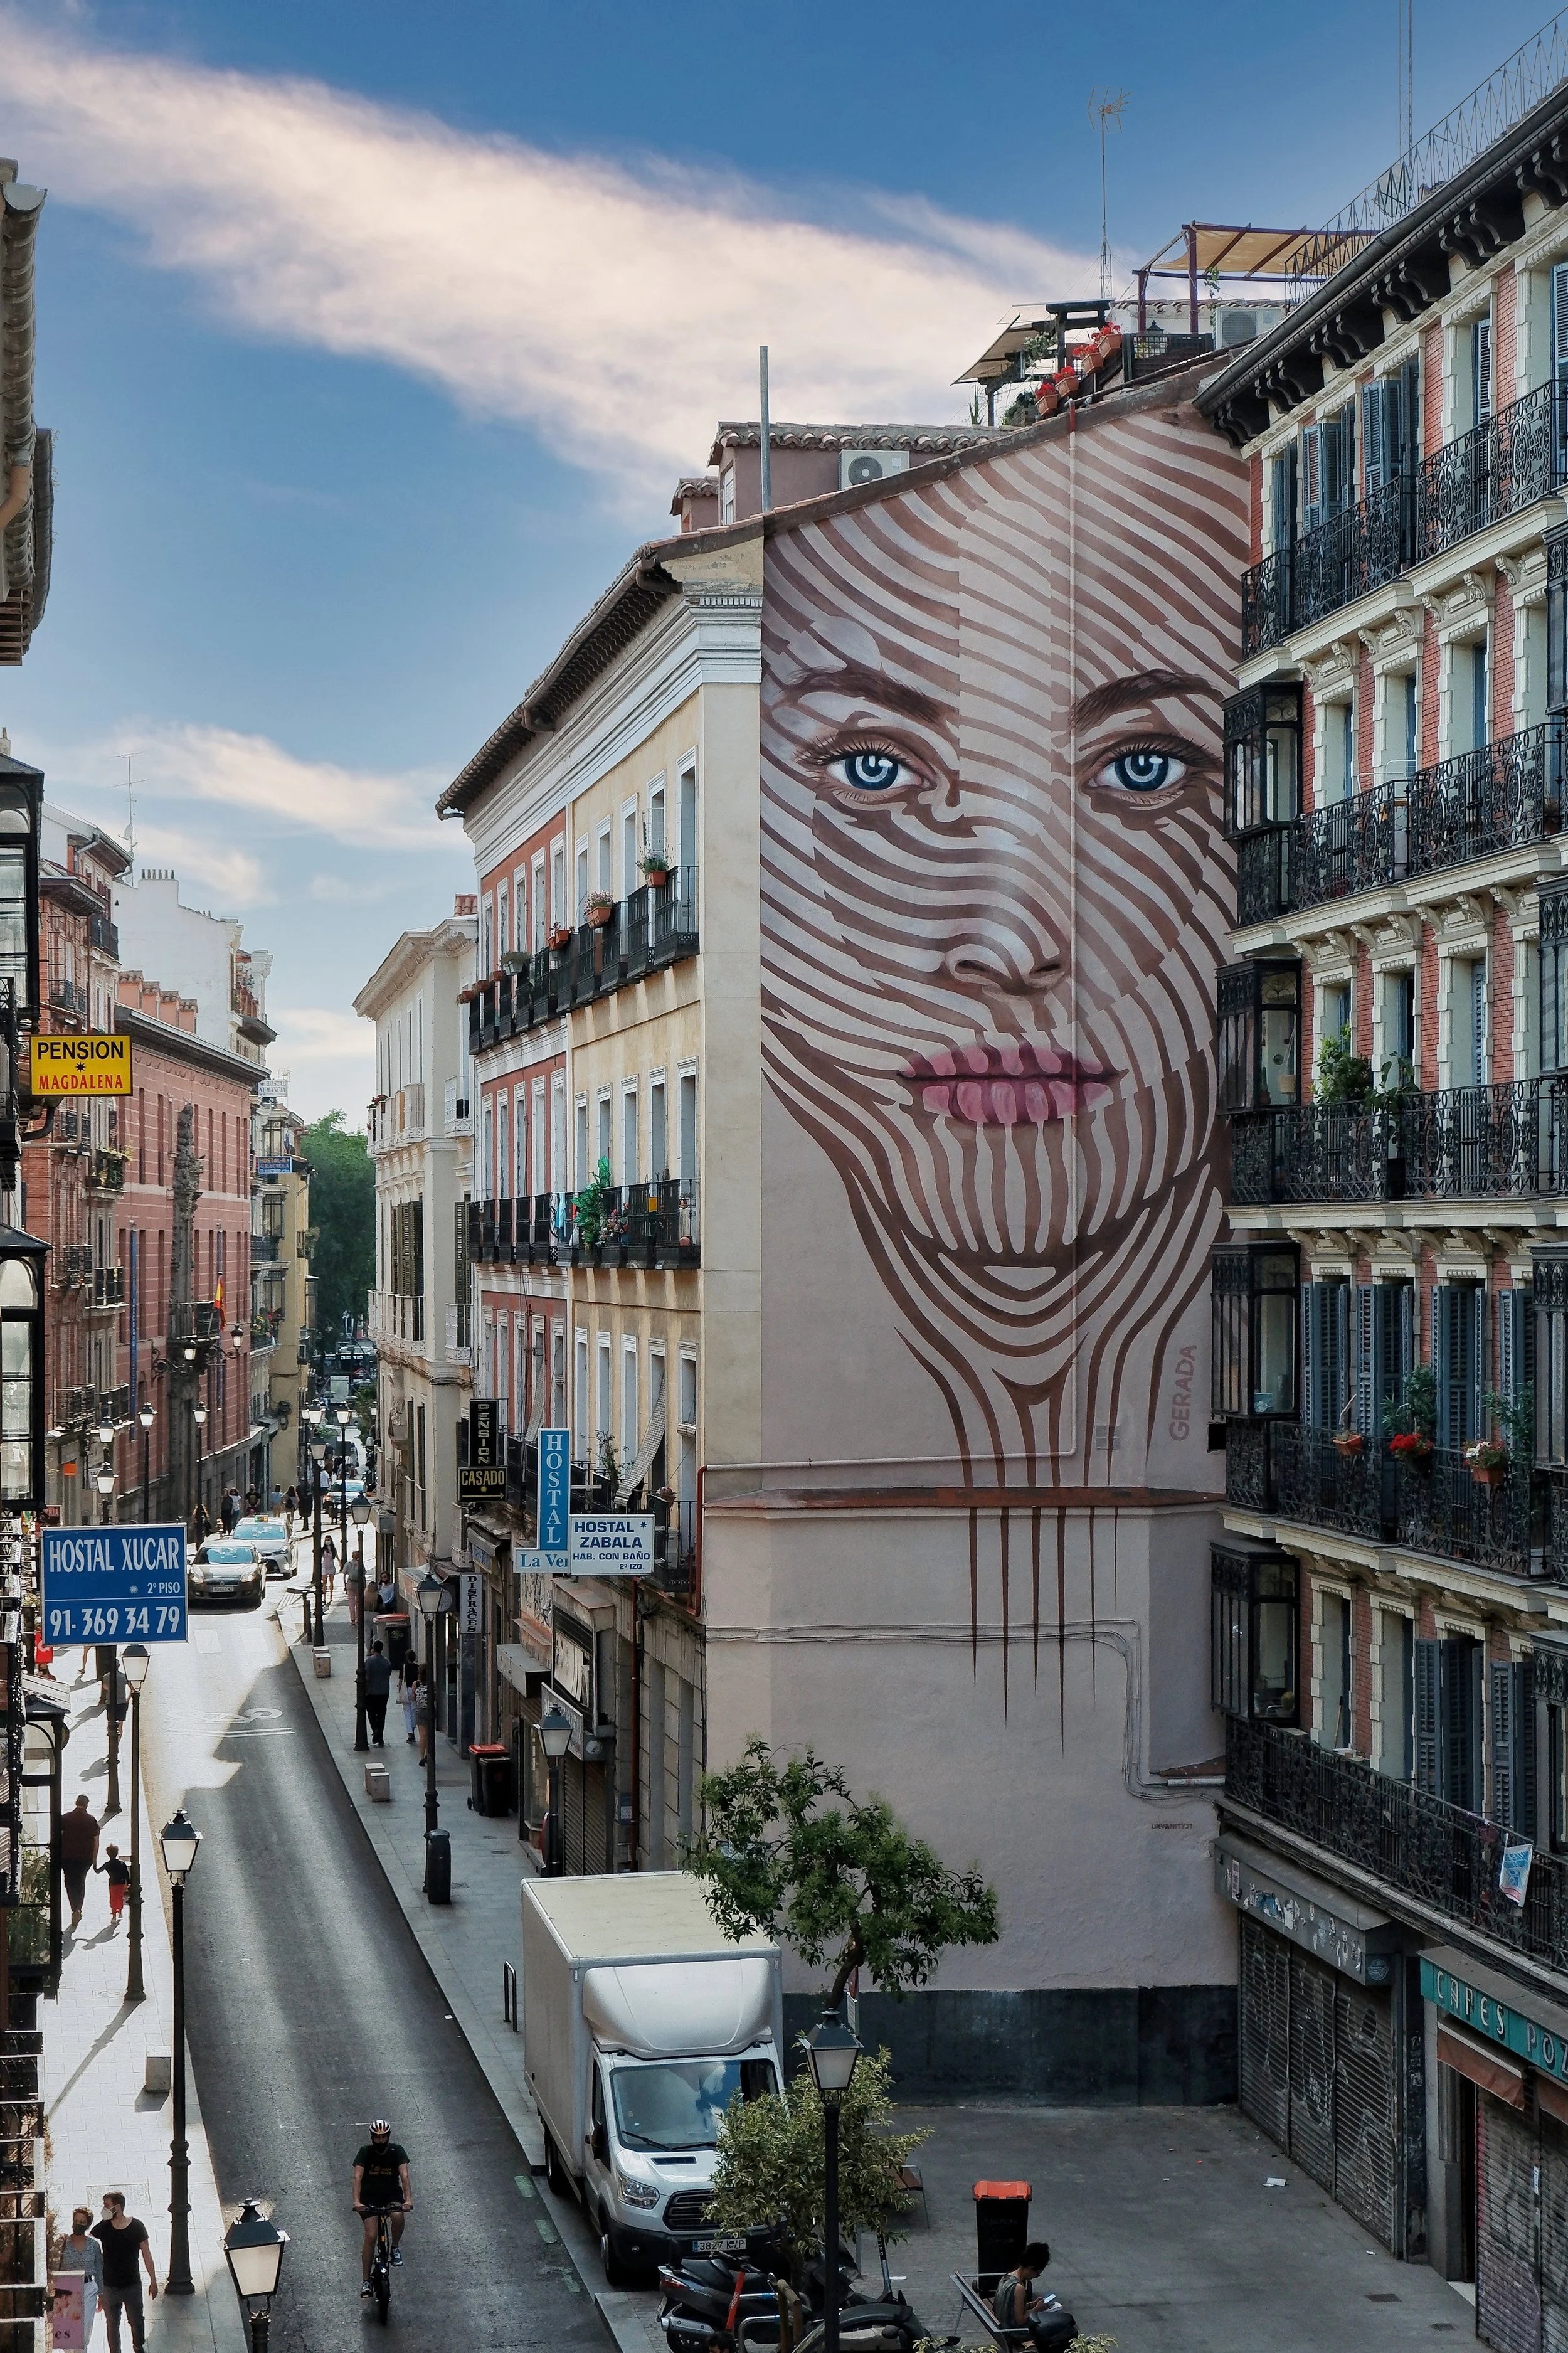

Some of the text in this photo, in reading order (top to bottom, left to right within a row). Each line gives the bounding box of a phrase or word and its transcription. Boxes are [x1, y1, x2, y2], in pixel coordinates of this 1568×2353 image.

[38, 1041, 124, 1060] PENSION
[39, 1075, 123, 1090] MAGDALENA
[1168, 1345, 1197, 1441] GERADA
[477, 1403, 490, 1464] PENSION
[461, 1470, 505, 1486] CASADO
[546, 1435, 563, 1543] HOSTAL
[575, 1521, 635, 1532] HOSTAL
[580, 1536, 642, 1548] ZABALA
[50, 1537, 179, 1573] HOSTAL XUCAR
[521, 1554, 541, 1567] La
[623, 1551, 650, 1560] BAÑO
[147, 1581, 181, 1594] 2º PISO
[467, 1576, 477, 1632] DISFRACES
[81, 1607, 119, 1636] 369
[125, 1607, 150, 1634] 34
[156, 1605, 180, 1633] 79
[1437, 1970, 1505, 2036] CAFES
